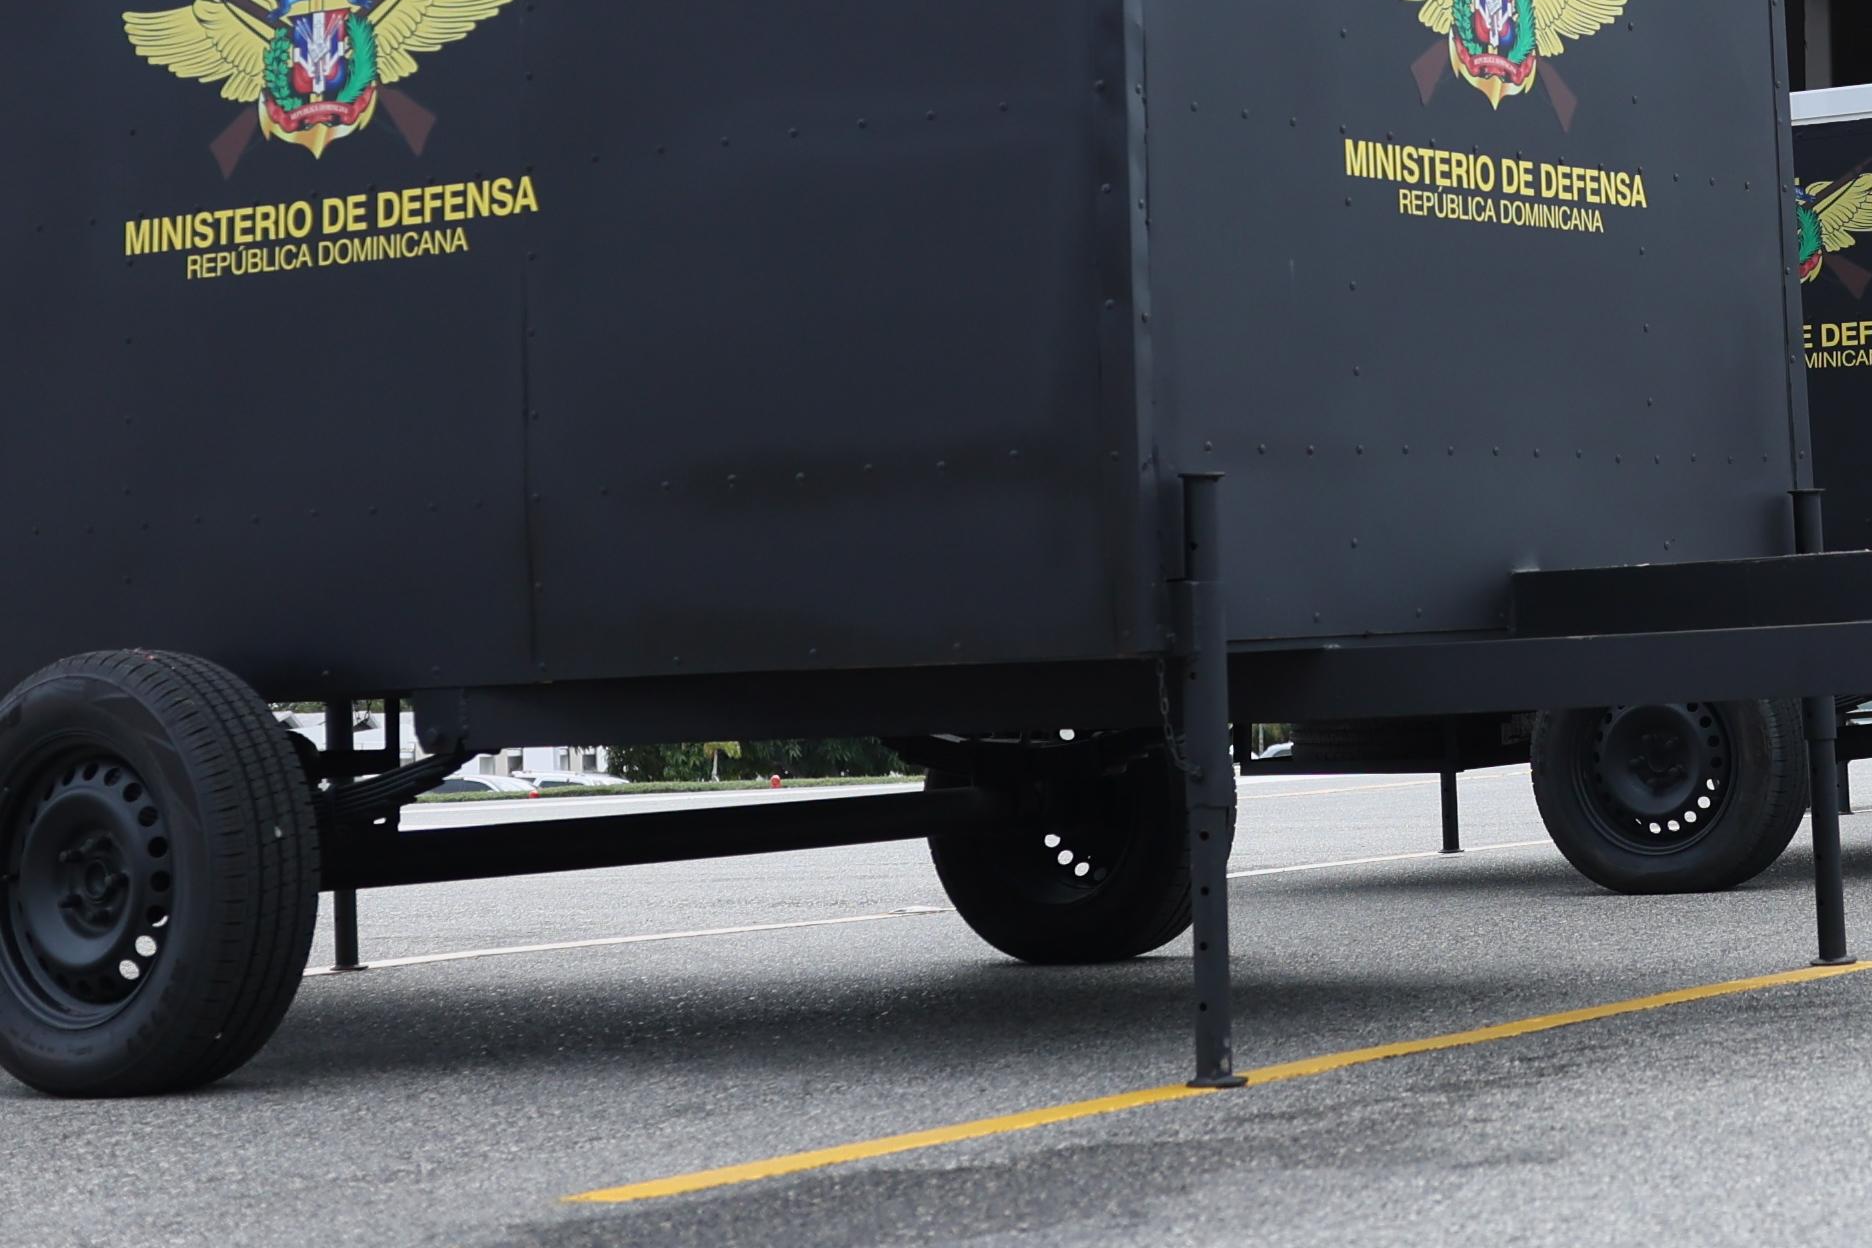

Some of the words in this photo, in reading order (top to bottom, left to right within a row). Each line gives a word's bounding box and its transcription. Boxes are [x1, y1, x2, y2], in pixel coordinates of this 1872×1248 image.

[1344, 138, 1495, 191] MINISTERIO
[1501, 158, 1535, 196] DE
[1540, 163, 1647, 208] DEFENSA
[125, 201, 312, 256] MINISTERIO
[322, 194, 368, 234] DE
[376, 176, 539, 228] DEFENSA
[1399, 186, 1497, 222] REPÚBLICA
[1500, 201, 1604, 233] DOMINICANA
[186, 245, 312, 279] REPÚBLICA
[317, 227, 468, 266] DOMINICANA
[1802, 324, 1813, 349] E
